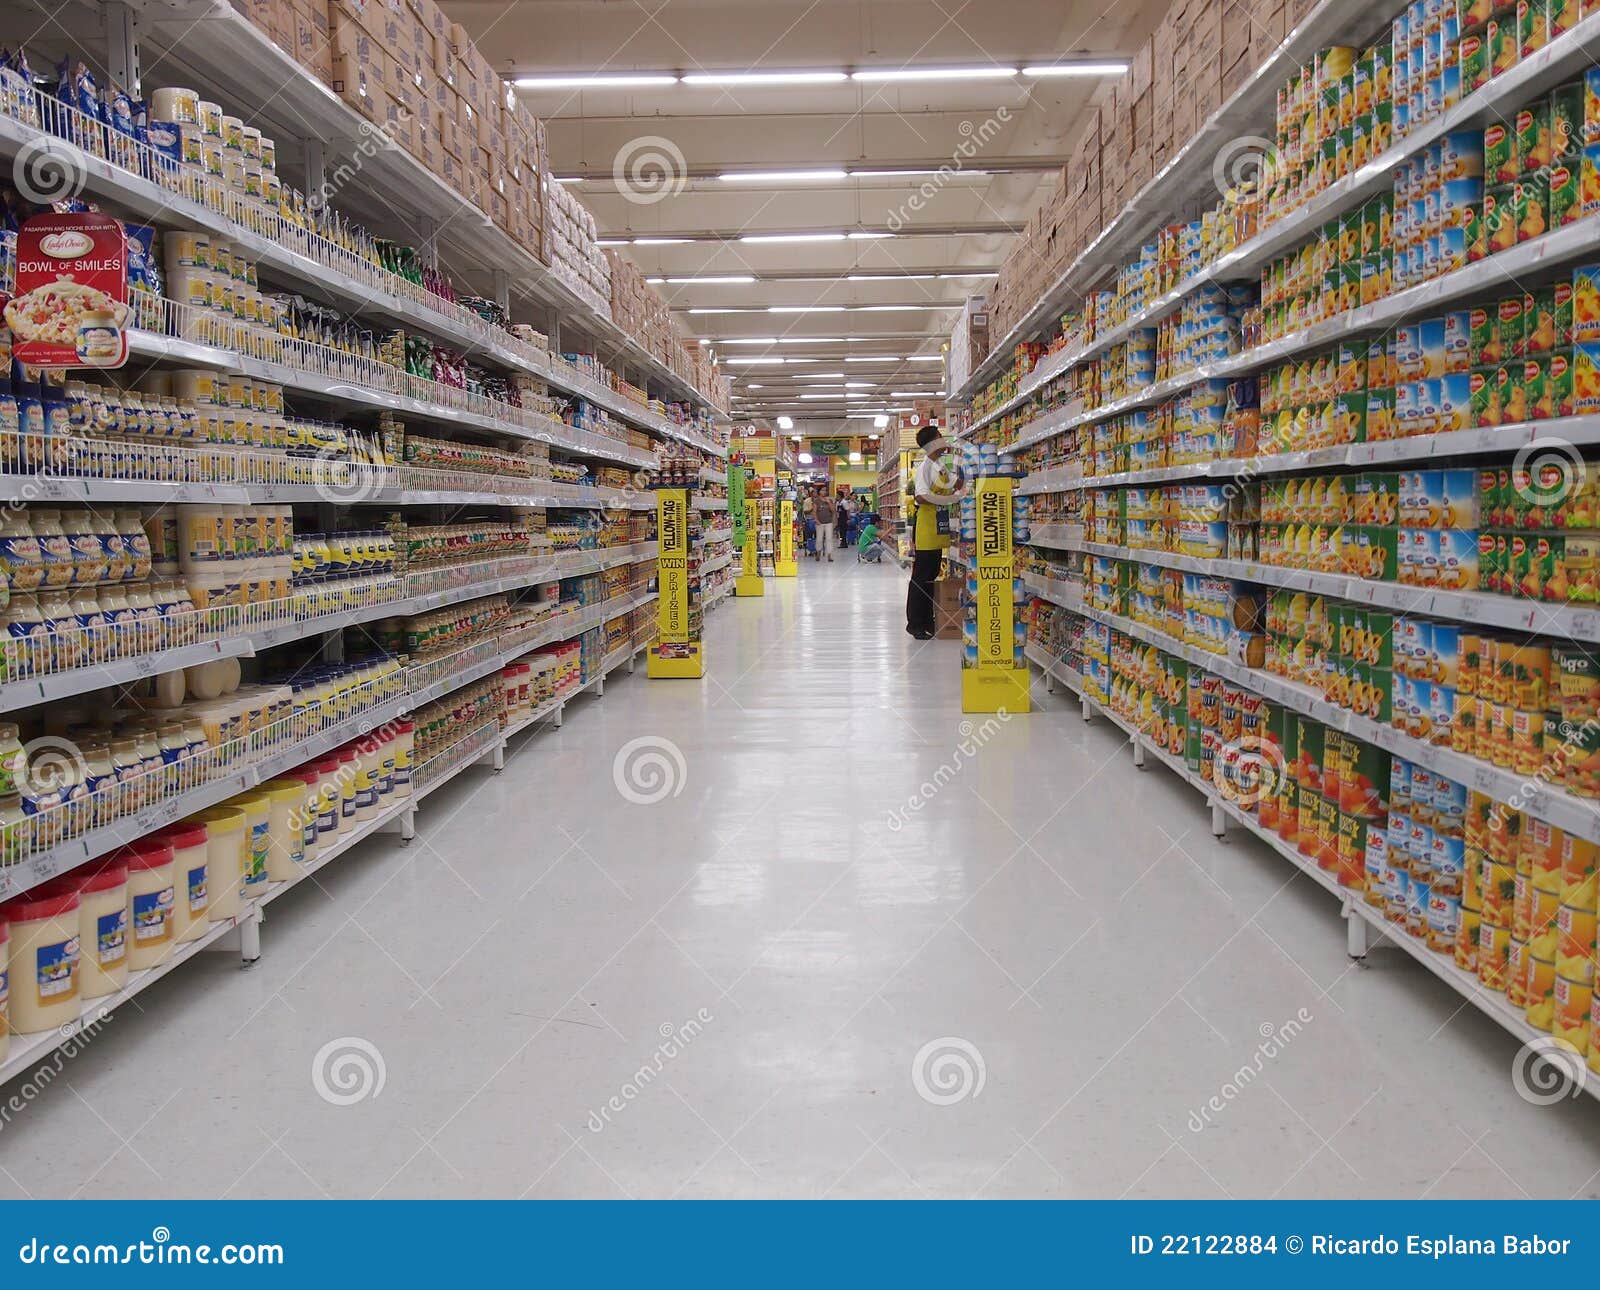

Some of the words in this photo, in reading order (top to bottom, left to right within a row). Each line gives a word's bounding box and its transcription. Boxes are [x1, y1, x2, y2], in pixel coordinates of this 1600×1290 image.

[64, 237, 85, 248] Choice
[19, 261, 56, 273] BOWL
[59, 261, 71, 270] OF
[74, 259, 121, 271] SMILES
[661, 557, 685, 569] WIN
[980, 566, 1010, 580] WIN
[669, 572, 679, 631] PRIZES
[989, 584, 1001, 656] PRIZES
